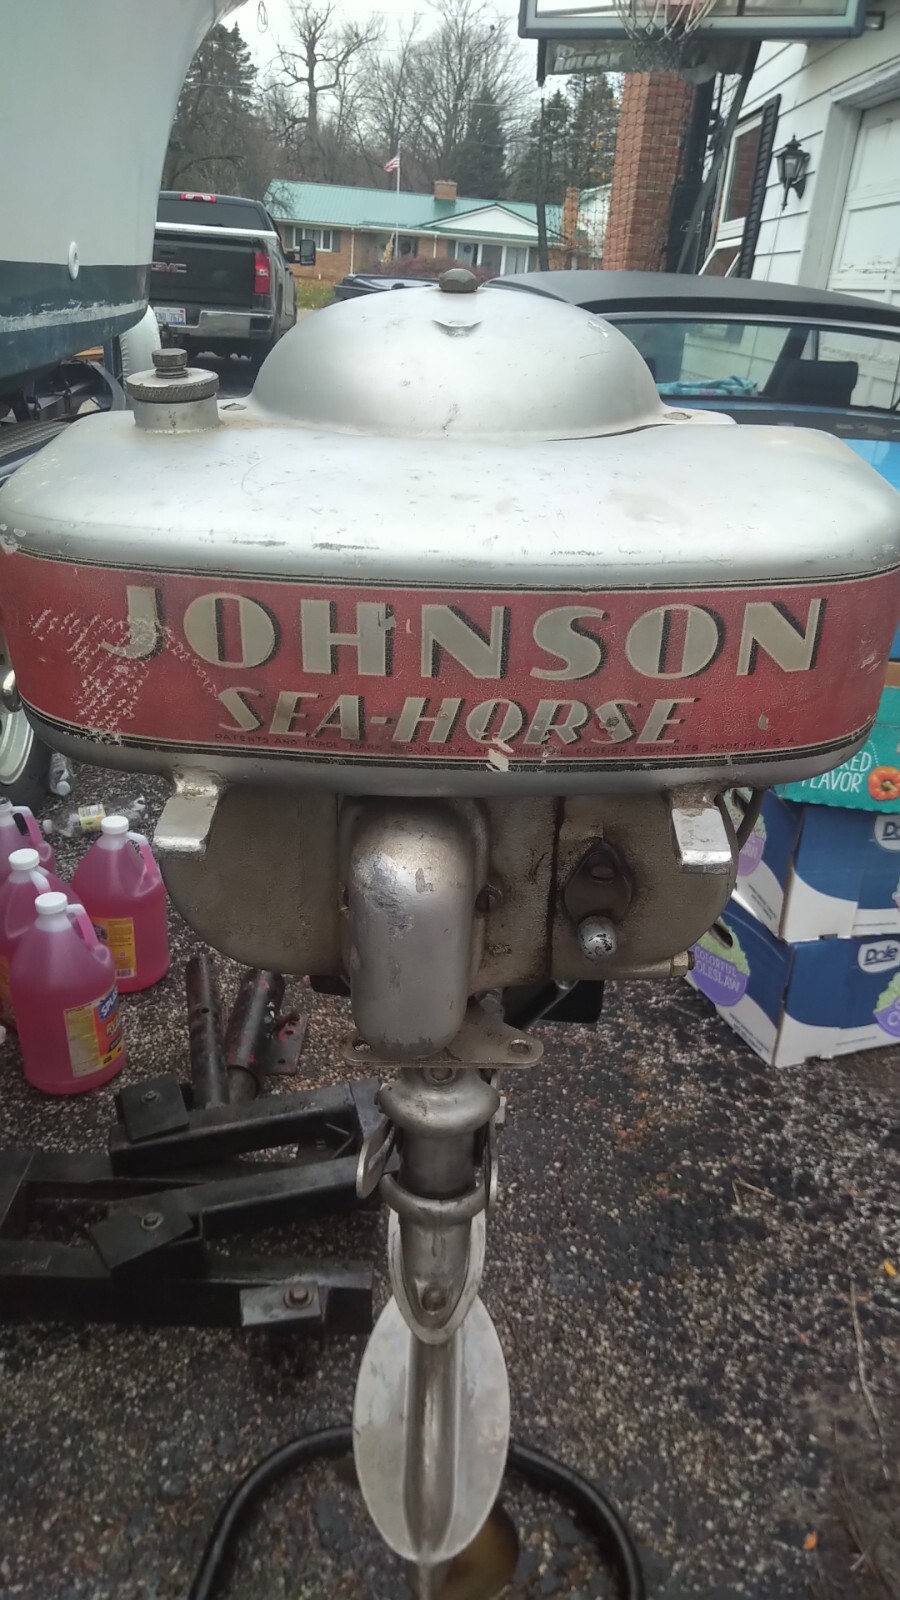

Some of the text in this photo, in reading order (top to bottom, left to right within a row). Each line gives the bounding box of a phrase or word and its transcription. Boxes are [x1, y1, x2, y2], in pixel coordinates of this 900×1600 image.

[98, 585, 825, 680] JOHNSON
[217, 686, 701, 745] SEA-HORSE
[274, 738, 297, 746] AND
[695, 946, 738, 978] COLORFUL
[865, 945, 898, 962] Dole
[695, 959, 741, 993] OLESLAW
